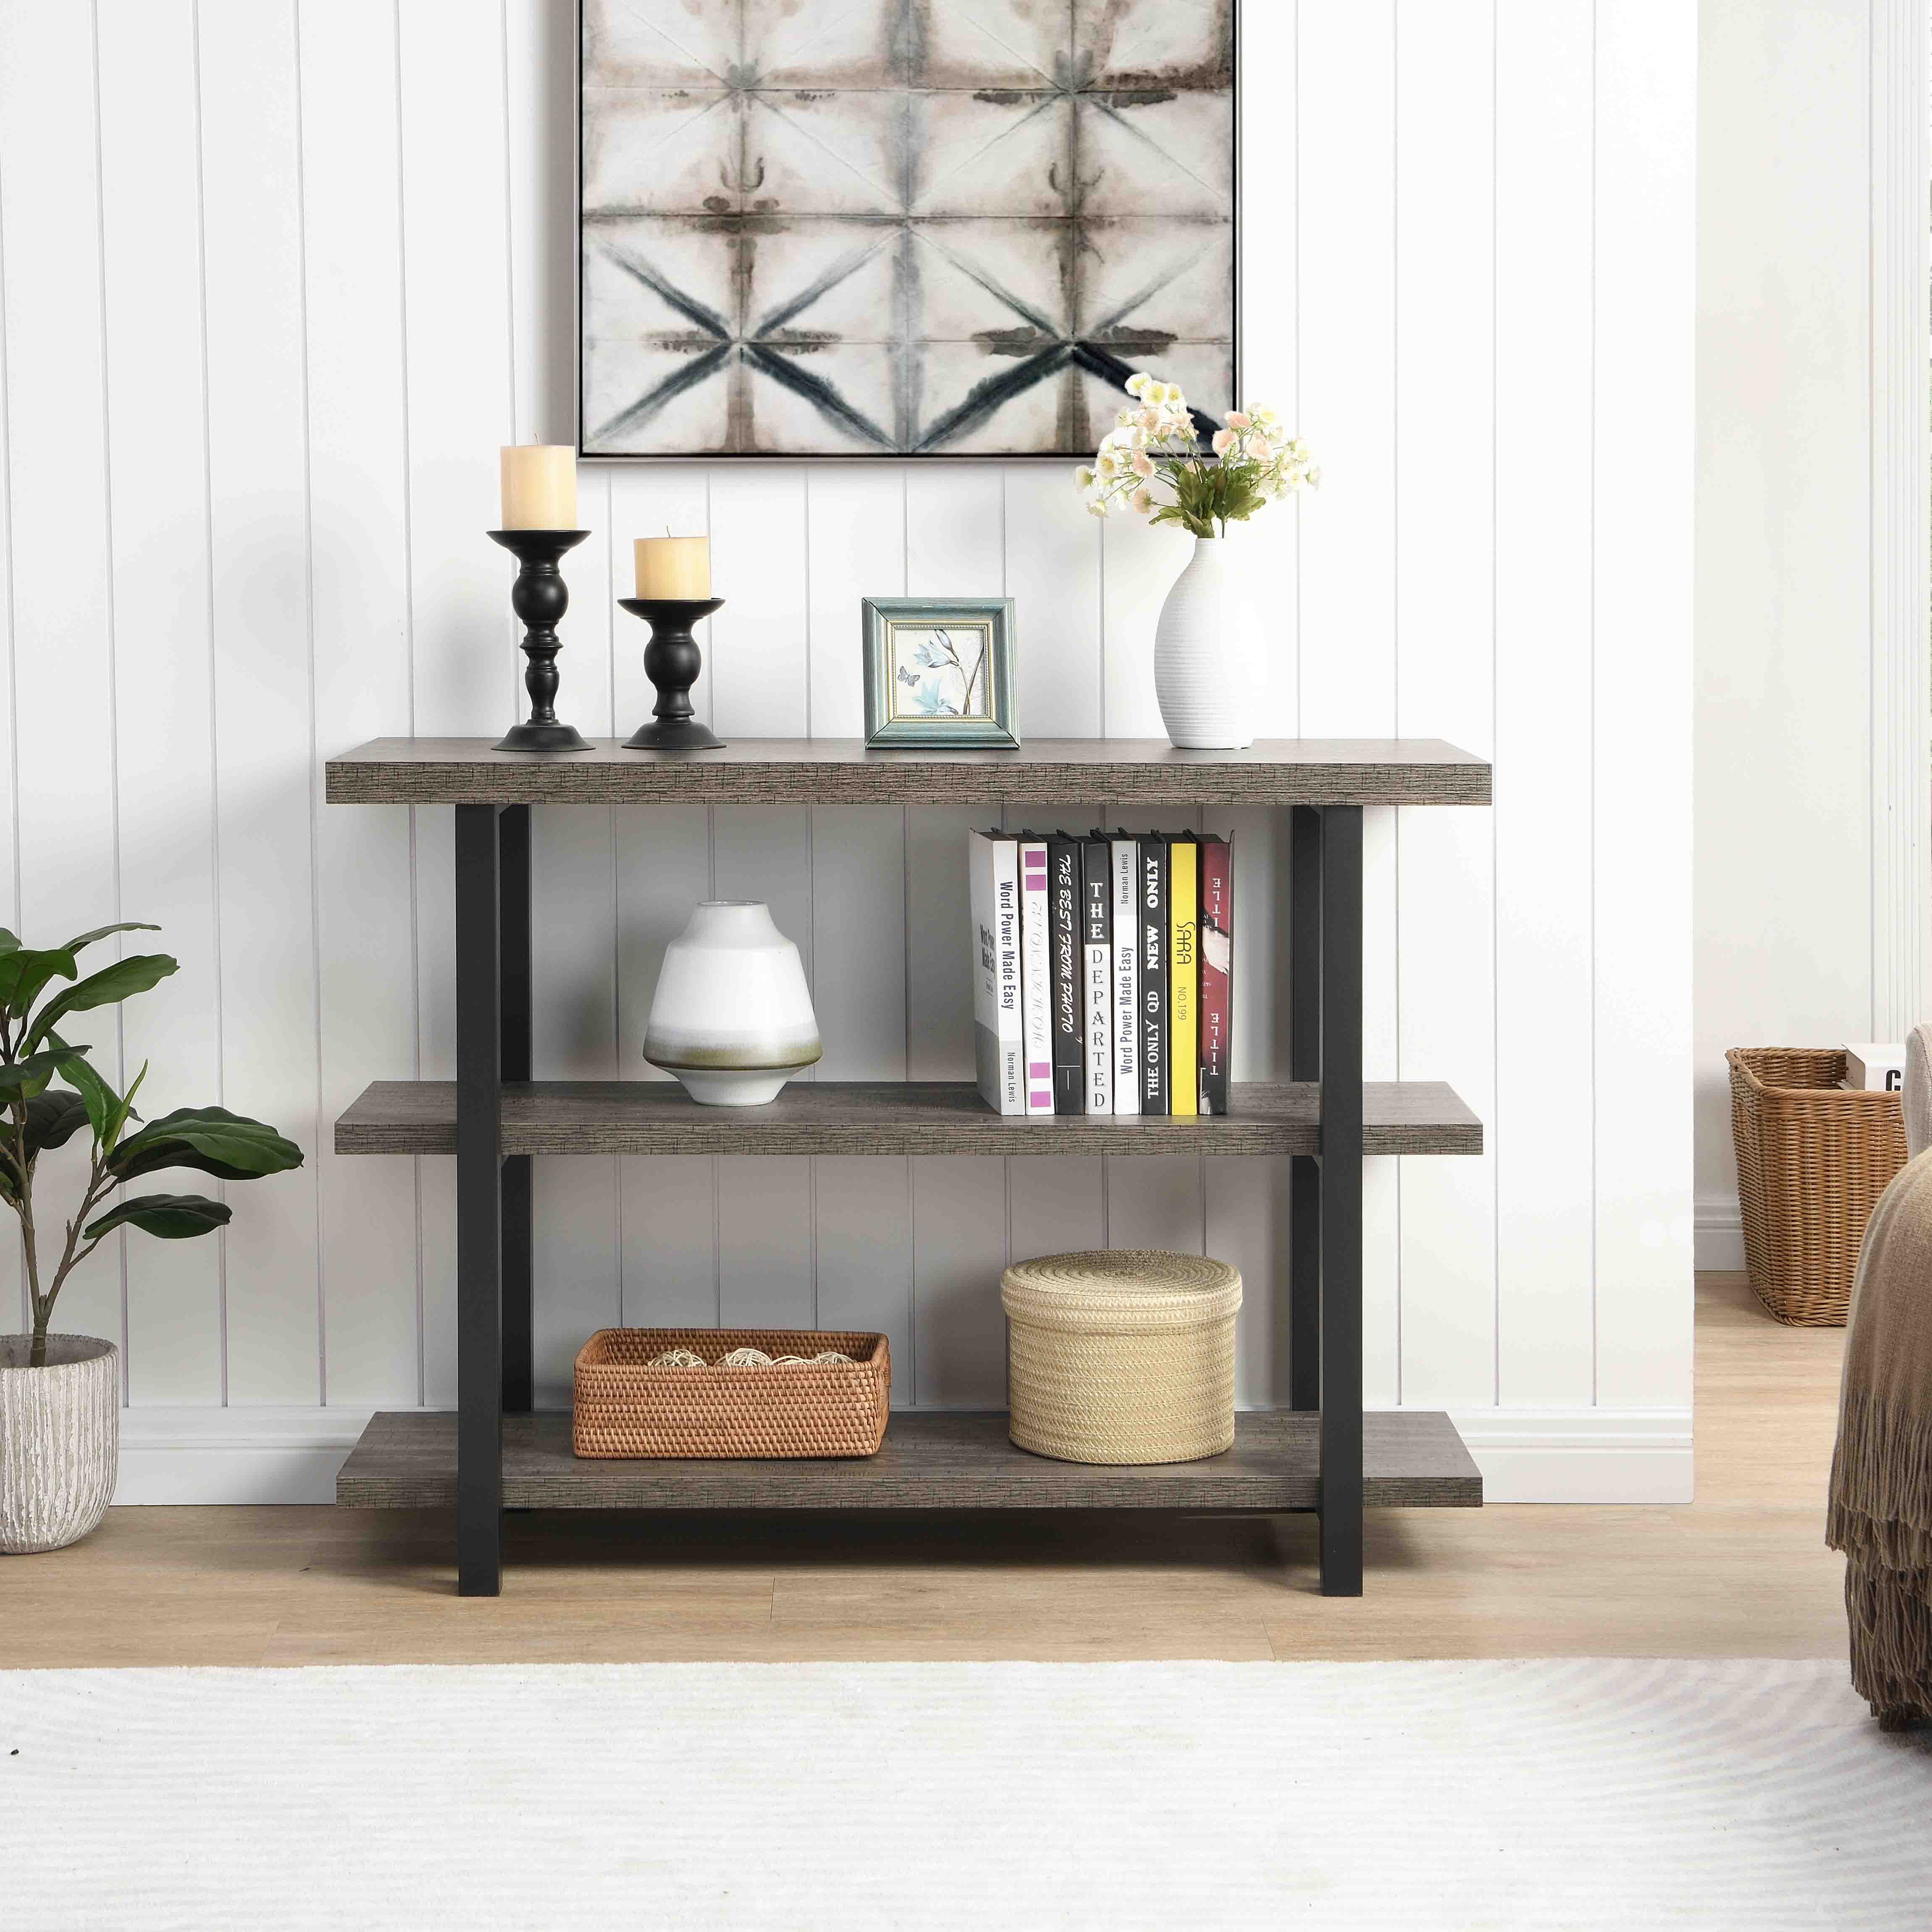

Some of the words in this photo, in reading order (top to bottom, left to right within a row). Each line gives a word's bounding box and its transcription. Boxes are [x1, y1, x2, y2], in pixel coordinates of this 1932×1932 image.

[1059, 855, 1071, 886] THE
[1120, 854, 1129, 874] Lewis
[1000, 881, 1013, 908] Word
[1120, 877, 1129, 904] Norman
[1147, 856, 1158, 908] ONLY
[1059, 889, 1072, 931] BEST
[1090, 883, 1104, 939] THE
[1001, 914, 1013, 946] Power
[1177, 921, 1195, 964] SARA
[1058, 934, 1072, 980] FROM
[1119, 947, 1134, 971] Easy
[1147, 925, 1159, 970] NEW
[1002, 951, 1015, 980] Made
[1001, 985, 1016, 1009] Easy
[1119, 976, 1131, 1005] Made
[1147, 991, 1159, 1013] QD
[1060, 982, 1074, 1033] PHOTO
[1092, 950, 1105, 1107] DEPARTED
[1120, 1011, 1132, 1041] Power
[1145, 1019, 1159, 1063] ONLY
[1210, 1013, 1220, 1075] TITLE
[1120, 1048, 1133, 1074] Word
[1147, 1066, 1159, 1099] THE
